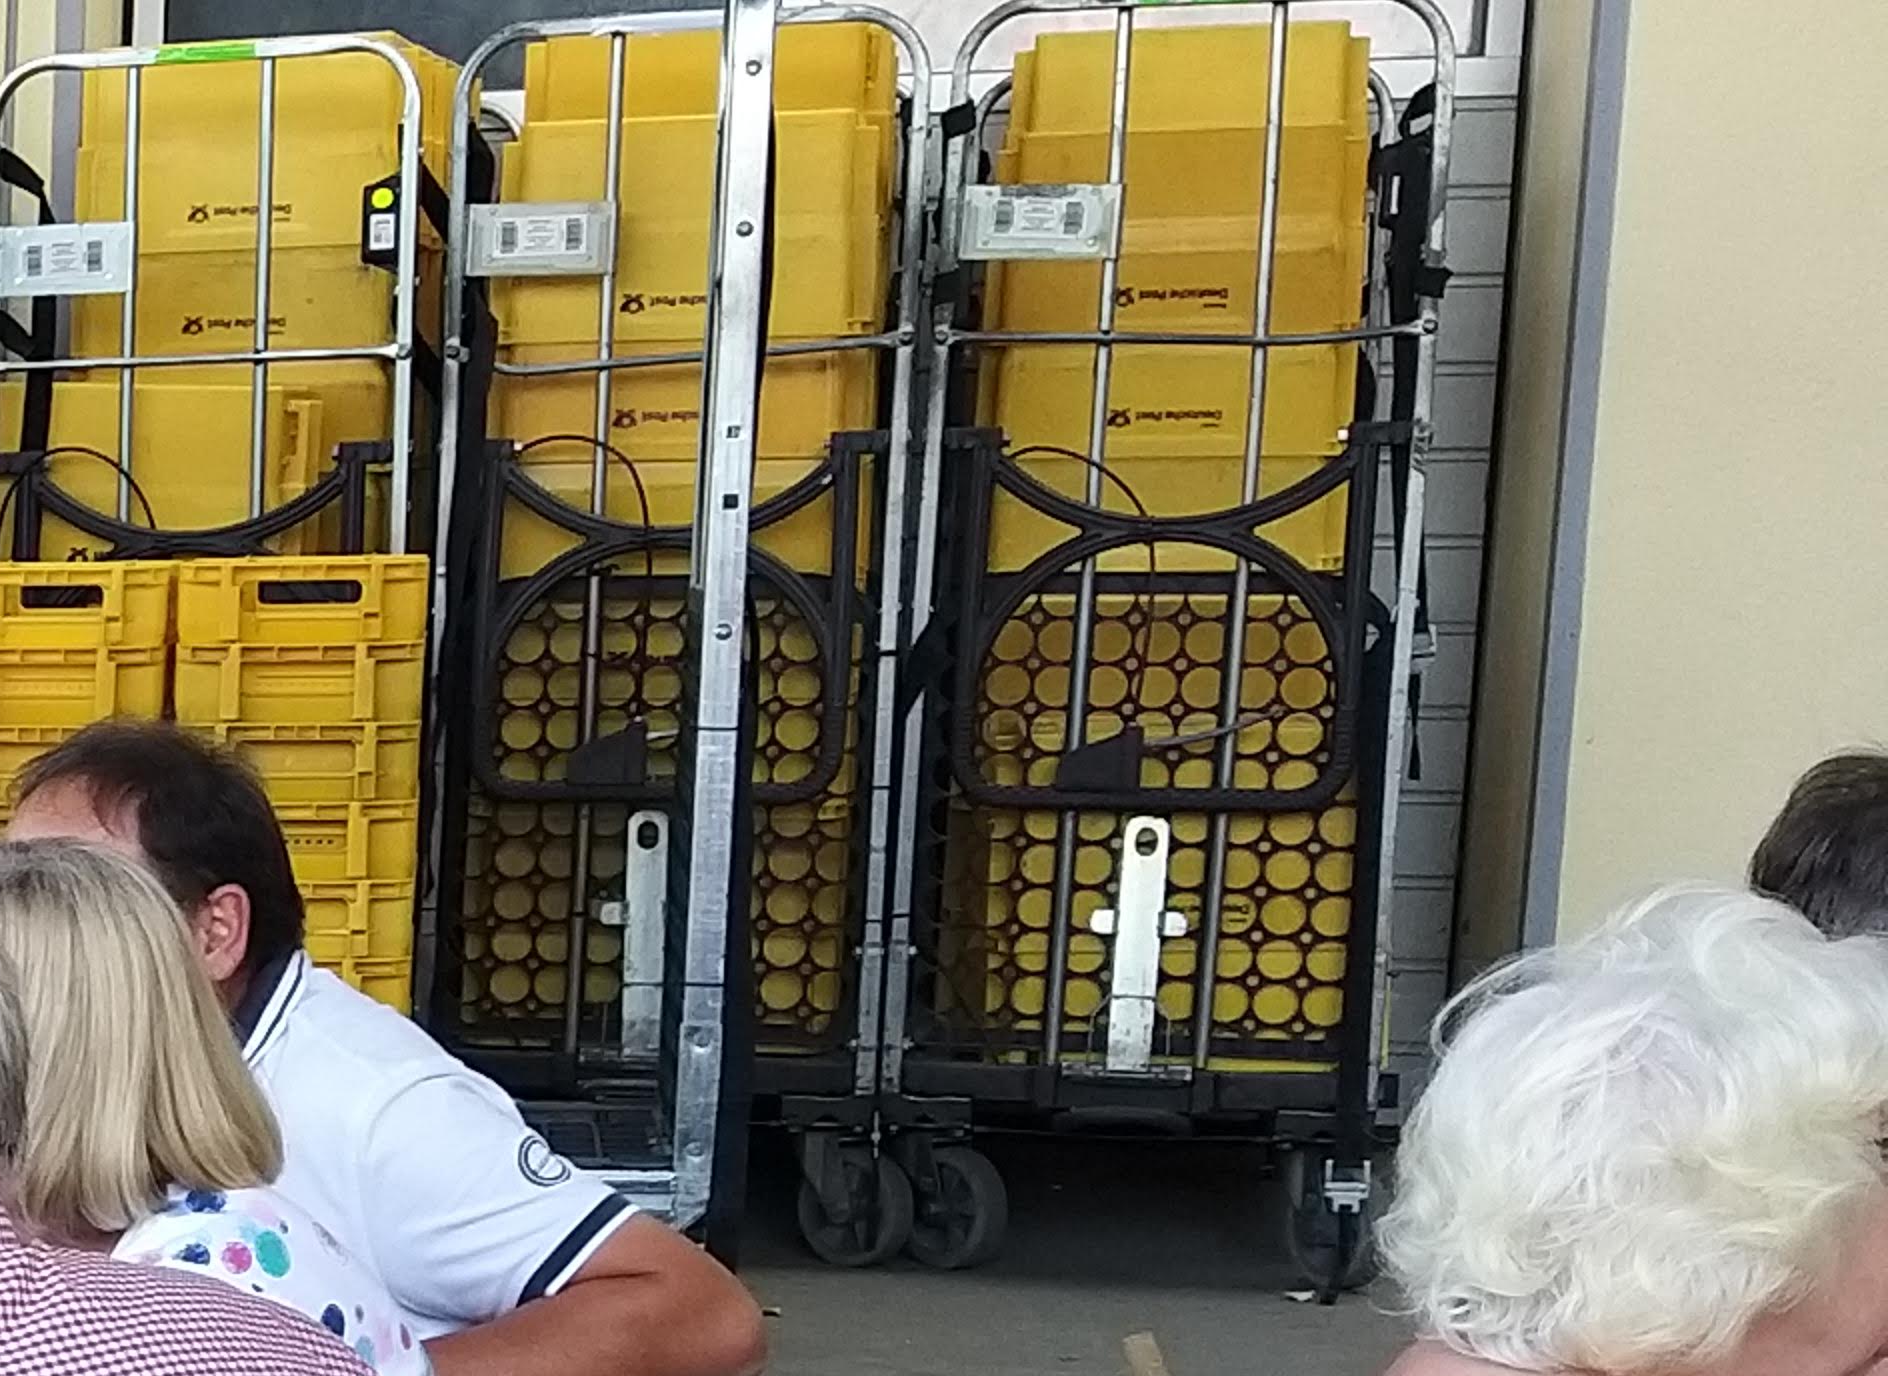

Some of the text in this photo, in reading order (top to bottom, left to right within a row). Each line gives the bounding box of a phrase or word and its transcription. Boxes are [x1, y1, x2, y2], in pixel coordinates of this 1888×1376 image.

[239, 203, 292, 215] Deche
[649, 295, 707, 307] sche Post
[233, 317, 287, 328] Deche
[671, 411, 699, 422] sche
